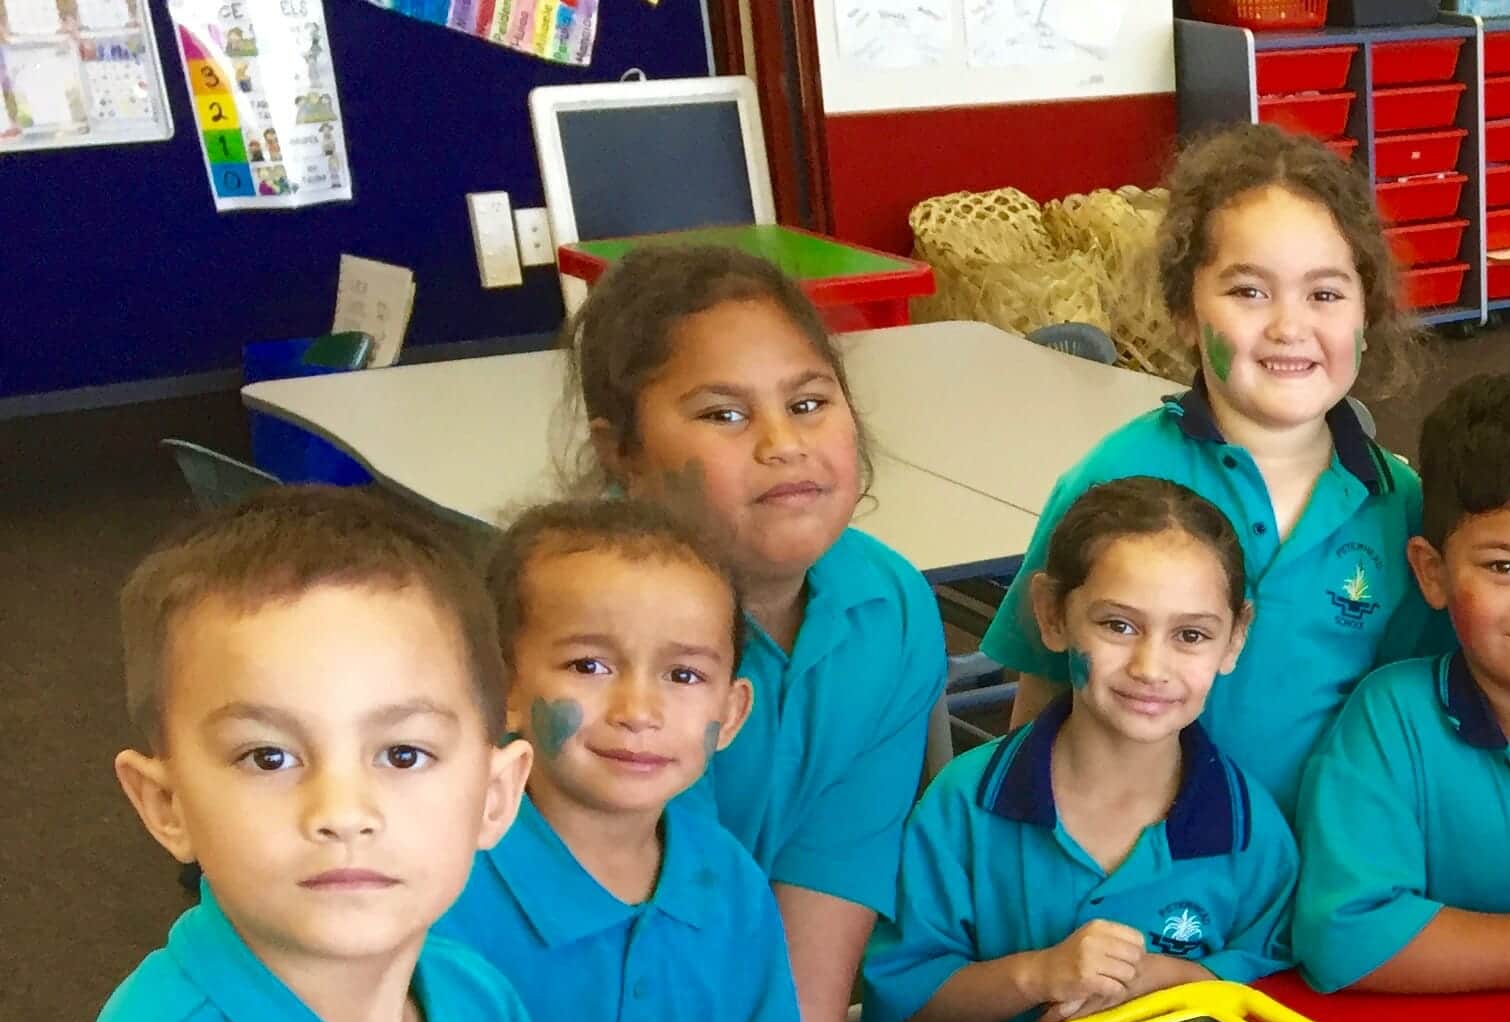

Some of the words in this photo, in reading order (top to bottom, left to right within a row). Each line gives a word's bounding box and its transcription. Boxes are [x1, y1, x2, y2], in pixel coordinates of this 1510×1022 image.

[200, 65, 220, 88] 3
[208, 101, 229, 122] 2
[218, 135, 230, 161] 1
